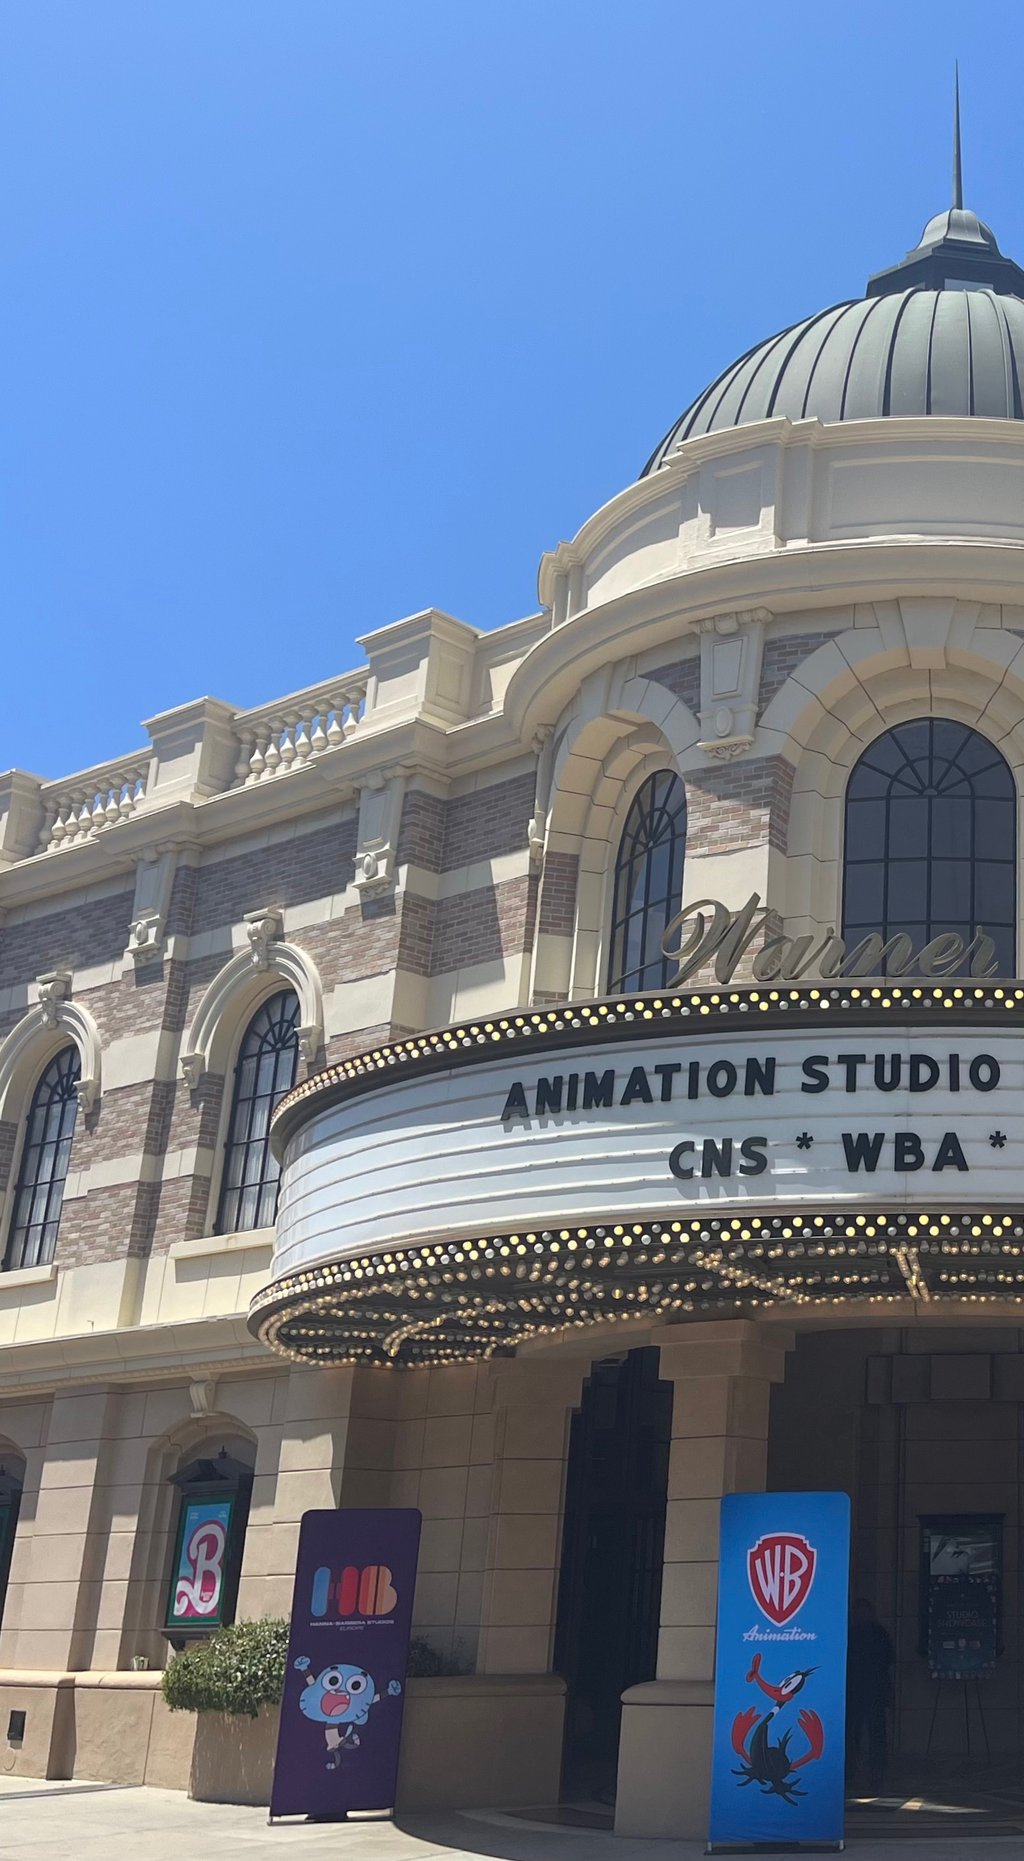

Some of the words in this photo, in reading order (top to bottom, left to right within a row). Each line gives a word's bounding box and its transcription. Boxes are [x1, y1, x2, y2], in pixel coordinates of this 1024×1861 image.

[661, 892, 999, 988] Warner
[501, 1057, 776, 1121] ANIMATION
[801, 1054, 1001, 1094] STUDIO
[669, 1136, 768, 1179] CNS
[842, 1132, 969, 1173] WBA
[310, 1565, 398, 1616] HB
[742, 1624, 817, 1642] Animation
